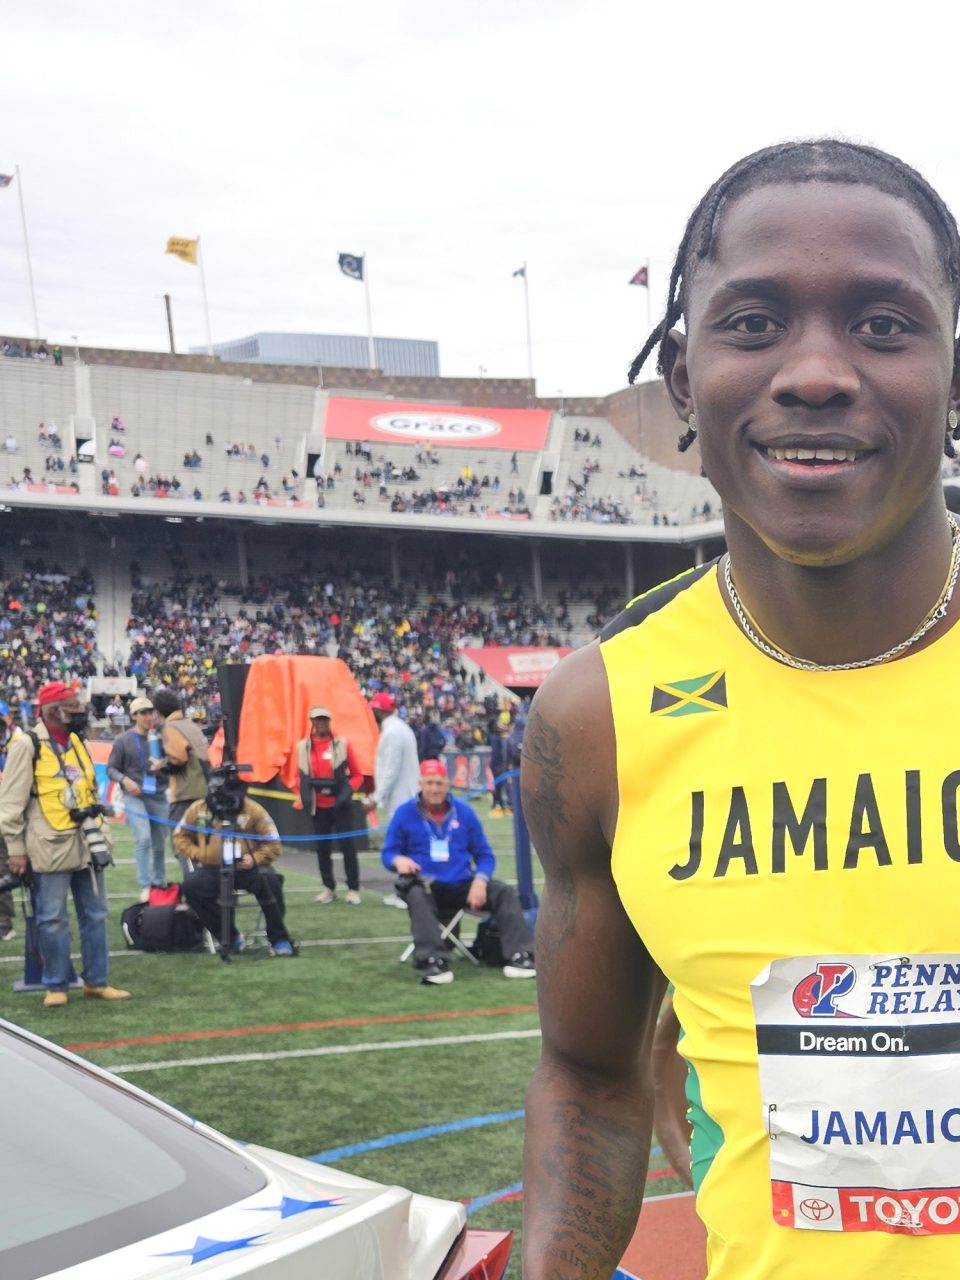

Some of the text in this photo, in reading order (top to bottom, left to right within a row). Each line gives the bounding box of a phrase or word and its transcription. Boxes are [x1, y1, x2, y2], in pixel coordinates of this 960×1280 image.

[389, 417, 482, 434] Grace
[799, 1031, 909, 1052] Dream On.
